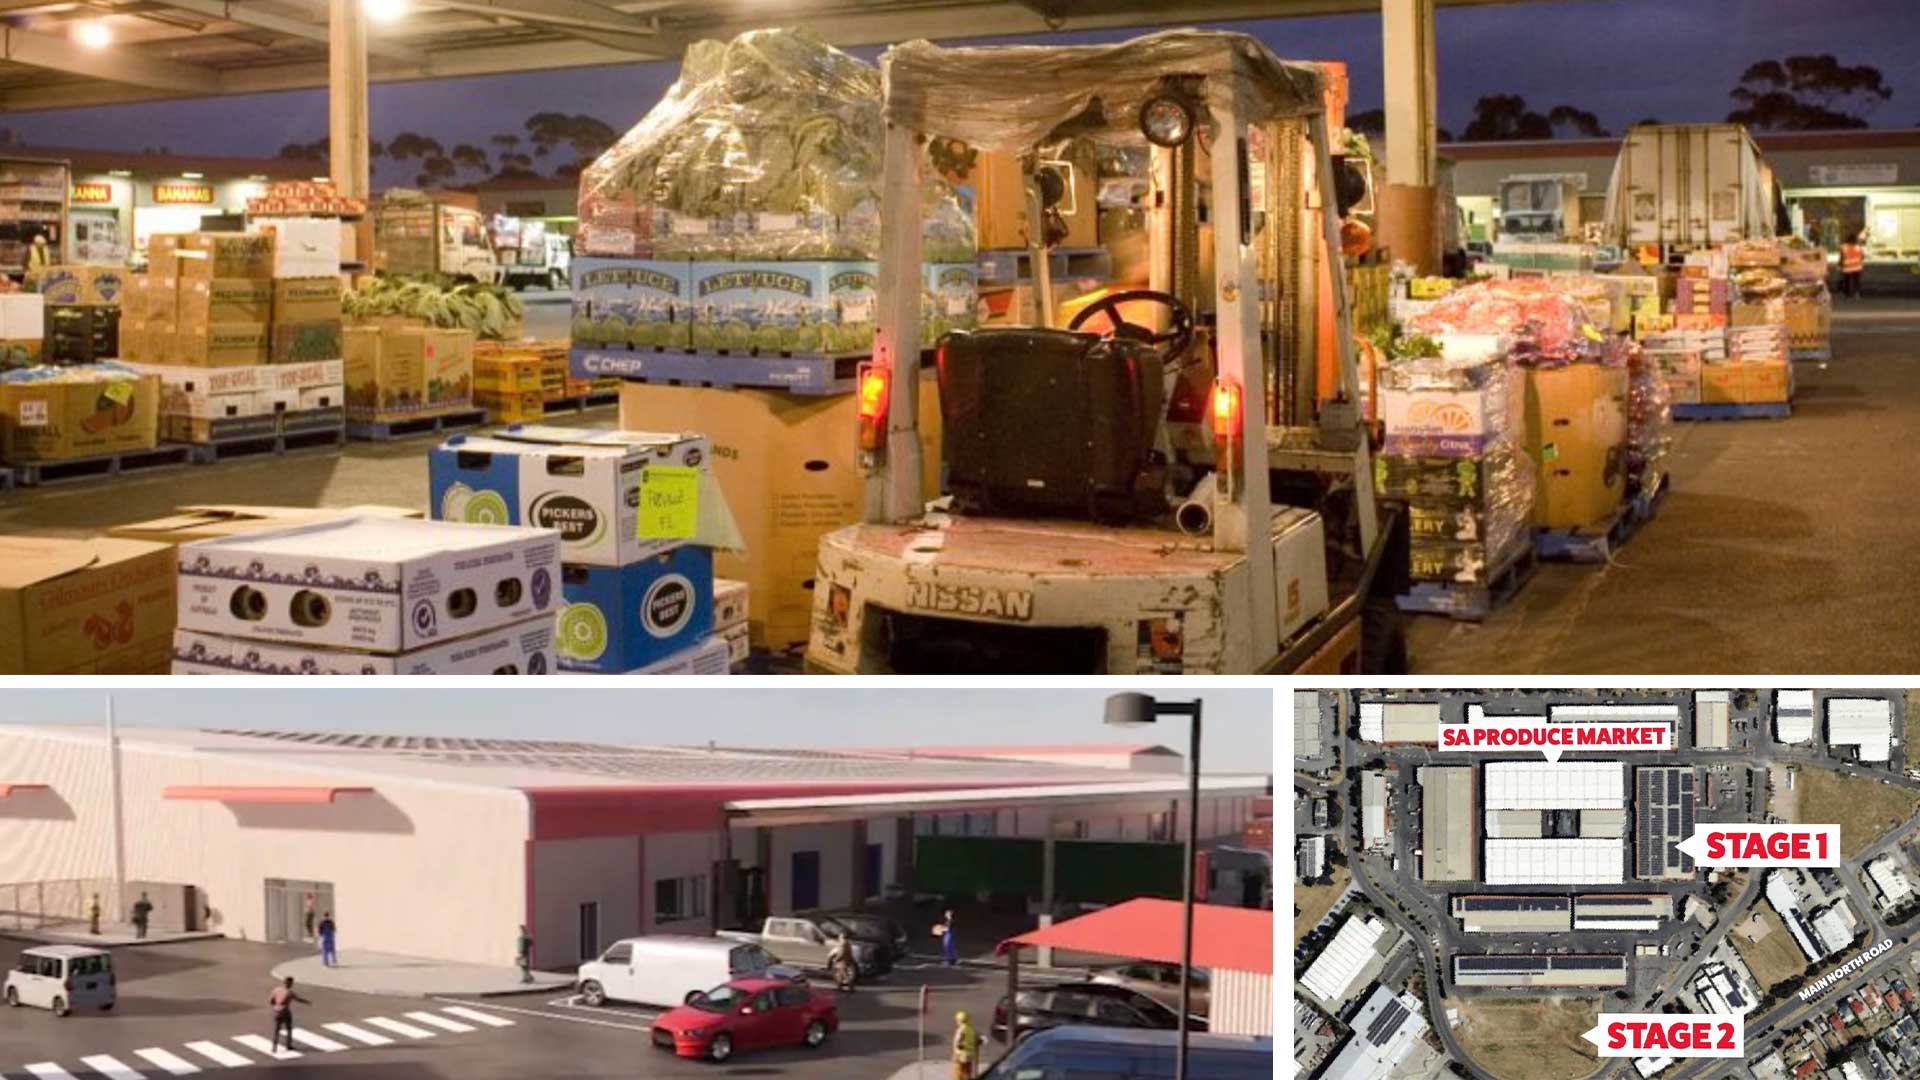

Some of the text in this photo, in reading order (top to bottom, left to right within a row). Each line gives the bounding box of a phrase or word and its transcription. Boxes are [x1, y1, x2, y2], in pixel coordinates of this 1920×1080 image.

[74, 184, 107, 200] ANNA
[157, 186, 210, 202] BANANAS
[583, 268, 676, 292] LETTUCE
[704, 271, 808, 294] LETTUCE
[600, 358, 642, 375] CHEP
[542, 506, 594, 520] PICKERS
[1411, 519, 1444, 533] ERY
[1412, 560, 1444, 575] ERY
[652, 590, 685, 611] PICKERS
[905, 581, 1033, 620] NISSAN
[659, 604, 679, 621] BEST
